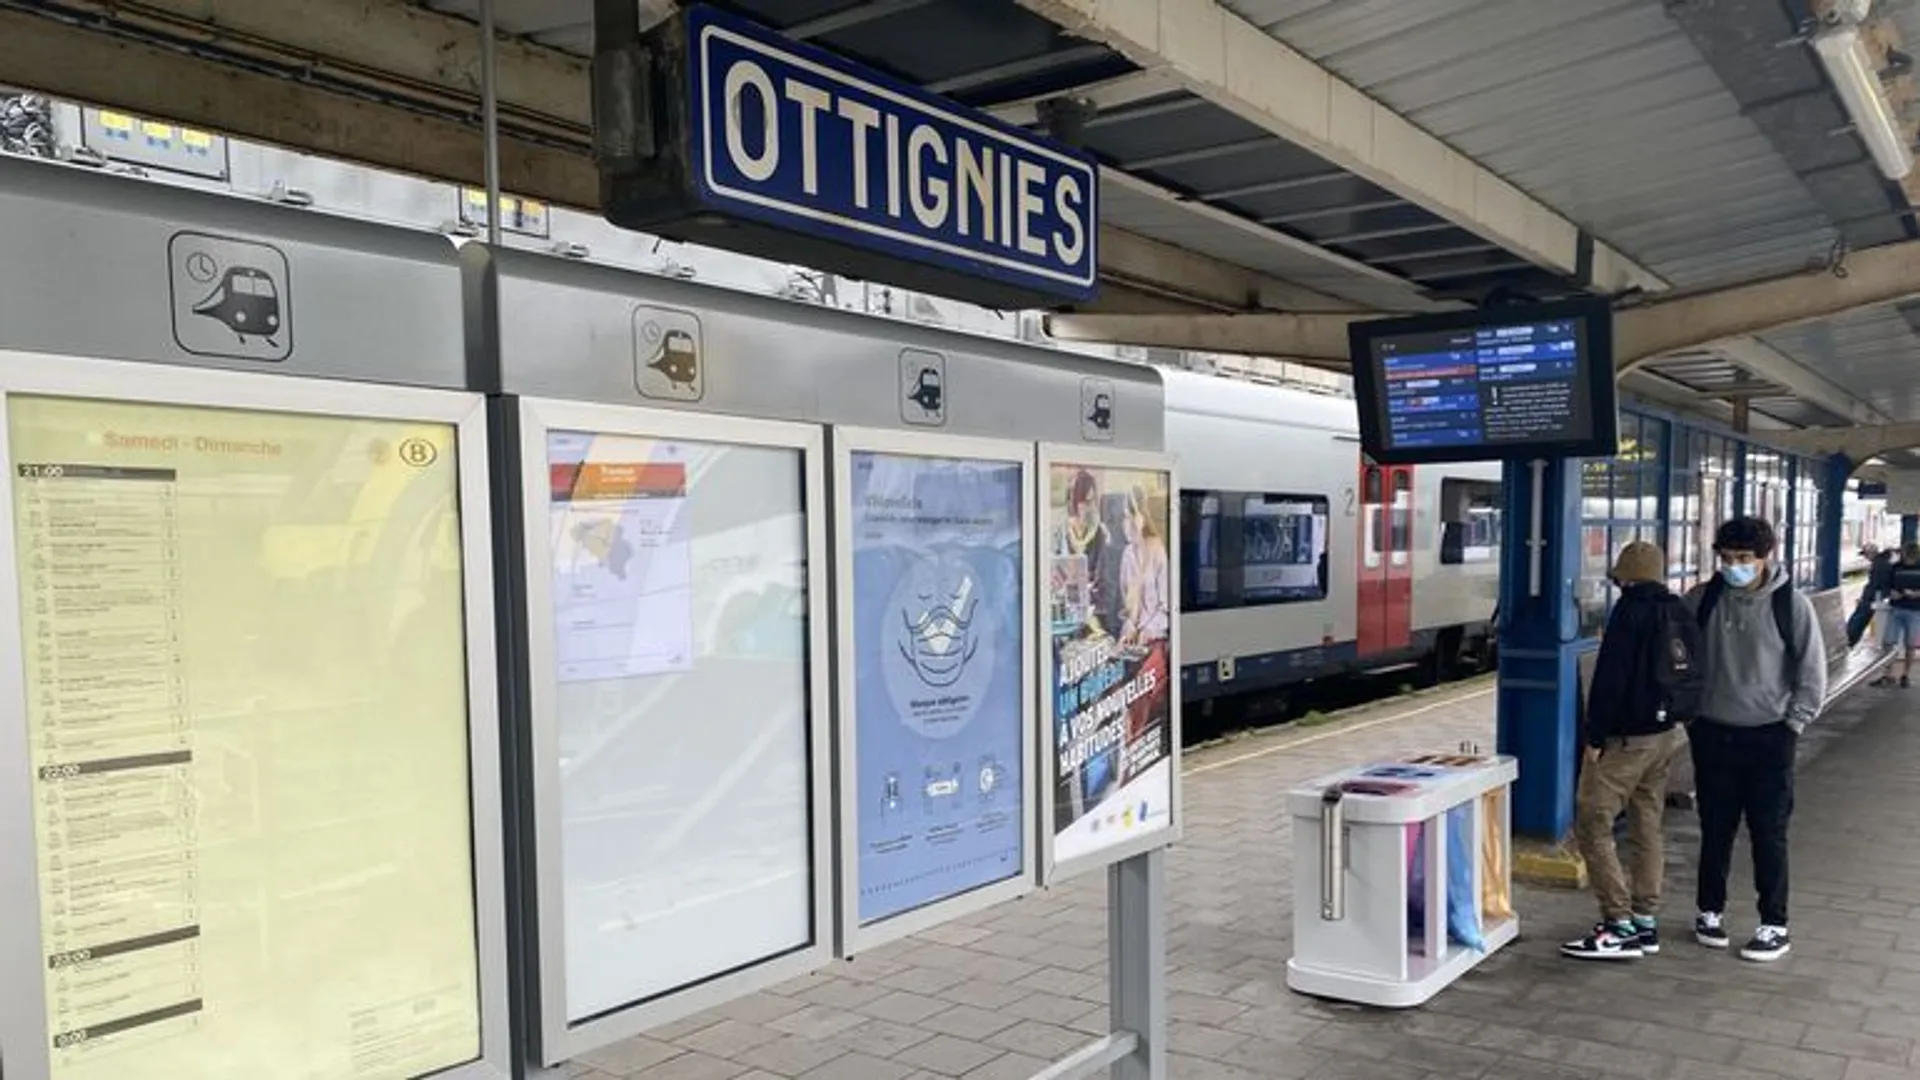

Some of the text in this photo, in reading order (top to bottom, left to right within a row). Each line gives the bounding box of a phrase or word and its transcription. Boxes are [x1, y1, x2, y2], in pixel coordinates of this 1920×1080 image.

[724, 59, 1085, 266] OTTIGNIES
[103, 430, 178, 451] Samedi
[195, 436, 282, 457] Dimanche
[1344, 487, 1356, 518] 2
